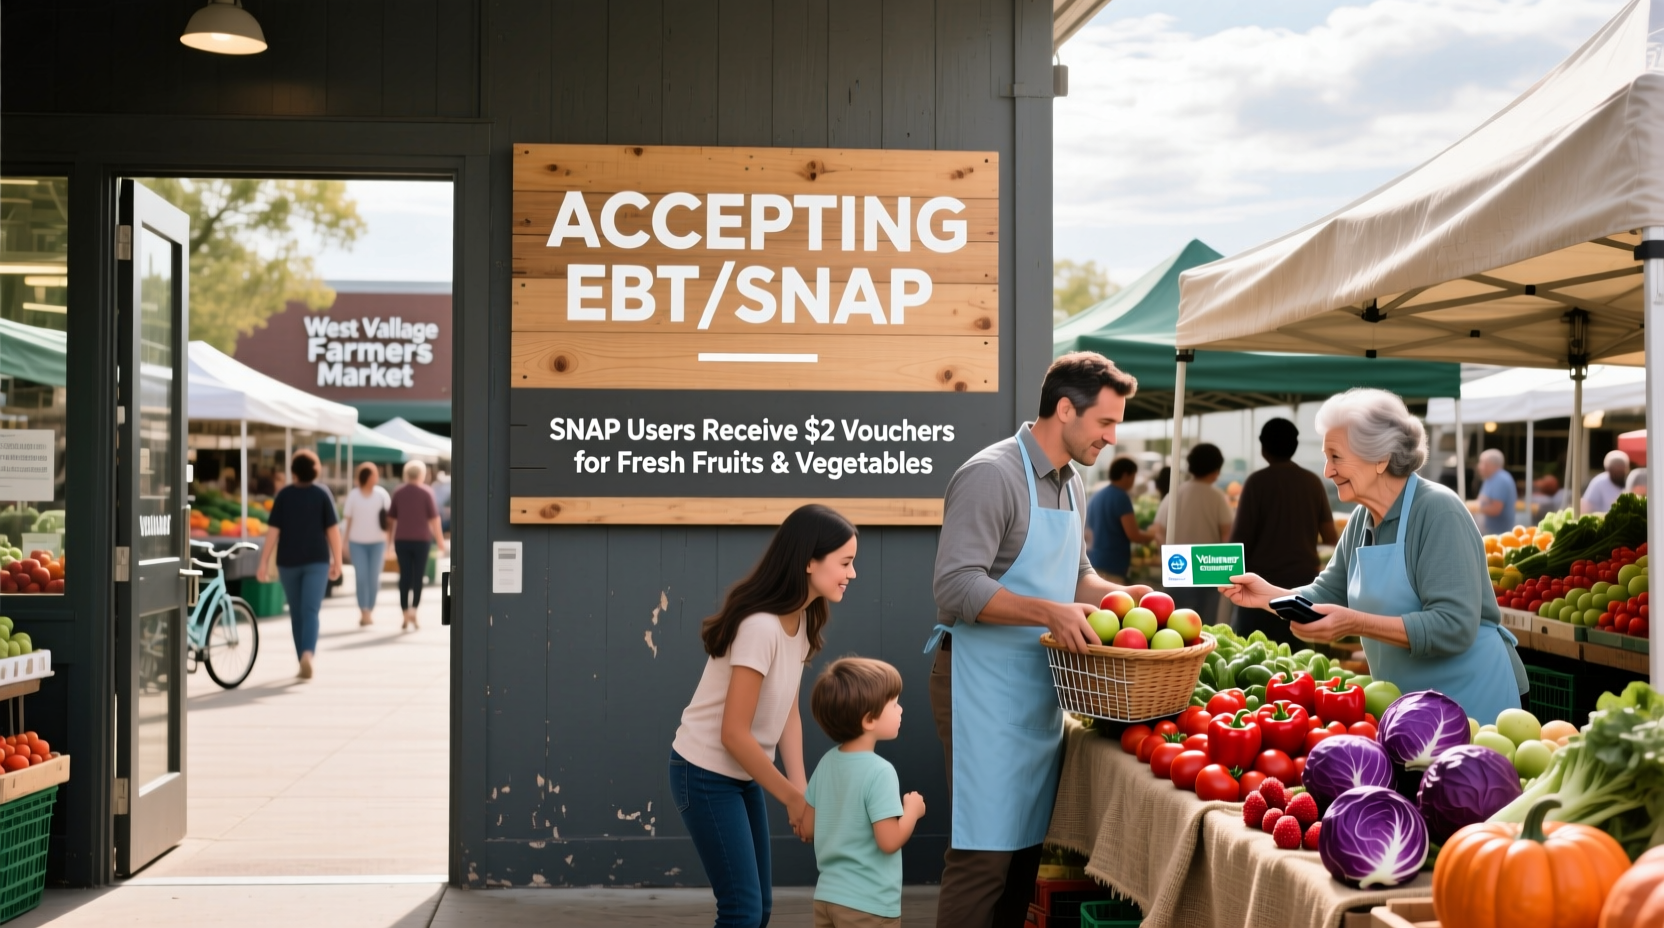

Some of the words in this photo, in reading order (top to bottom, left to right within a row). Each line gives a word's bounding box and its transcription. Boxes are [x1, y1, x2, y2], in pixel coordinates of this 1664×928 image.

[546, 190, 968, 254] ACCEPTING
[567, 260, 933, 330] EBT/SNAP
[303, 316, 359, 339] West
[361, 316, 439, 344] Vallage
[307, 337, 434, 365] Farmers
[317, 361, 414, 388] Market
[549, 417, 621, 441] SNAP
[627, 417, 696, 442] Users
[702, 417, 799, 442] Receive
[804, 414, 835, 446] $2
[840, 418, 956, 443] Vouchers
[573, 449, 611, 474] for
[617, 450, 685, 474] Fresh
[692, 449, 764, 474] Fruits
[770, 450, 790, 474] &
[794, 450, 934, 480] Vegetables
